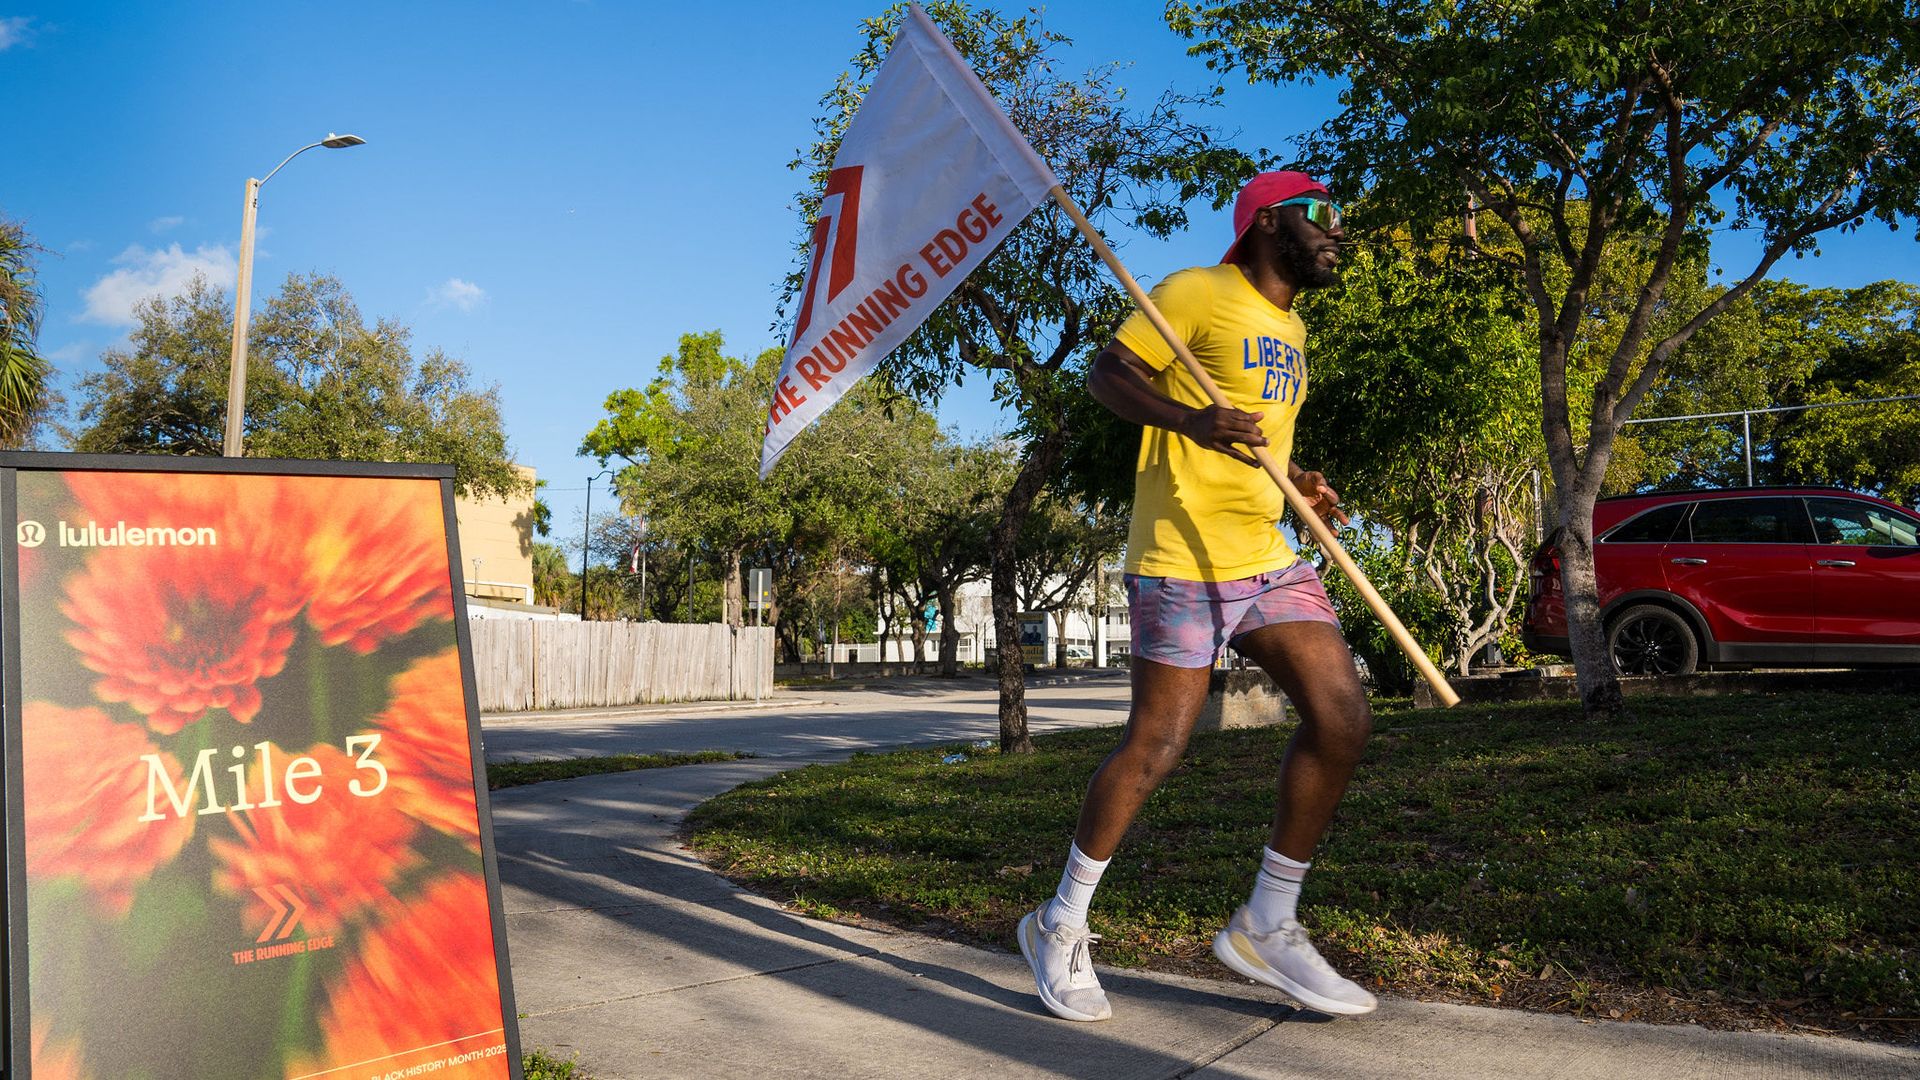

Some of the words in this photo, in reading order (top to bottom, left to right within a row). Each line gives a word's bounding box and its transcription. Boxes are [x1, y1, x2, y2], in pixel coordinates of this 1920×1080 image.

[765, 374, 808, 436] HE
[795, 263, 928, 391] RUNNING
[919, 192, 1003, 279] EDGE
[1243, 336, 1308, 378] LIBERT
[1262, 369, 1301, 406] CITY
[59, 520, 217, 547] lululemon
[138, 741, 323, 822] Mile
[345, 733, 388, 797] 3
[232, 950, 254, 965] THE
[256, 940, 306, 960] RUNNING
[307, 935, 335, 951] EDGE
[406, 1059, 447, 1077] HISTORY
[448, 1050, 484, 1067] MONTH
[485, 1043, 507, 1058] 2025
